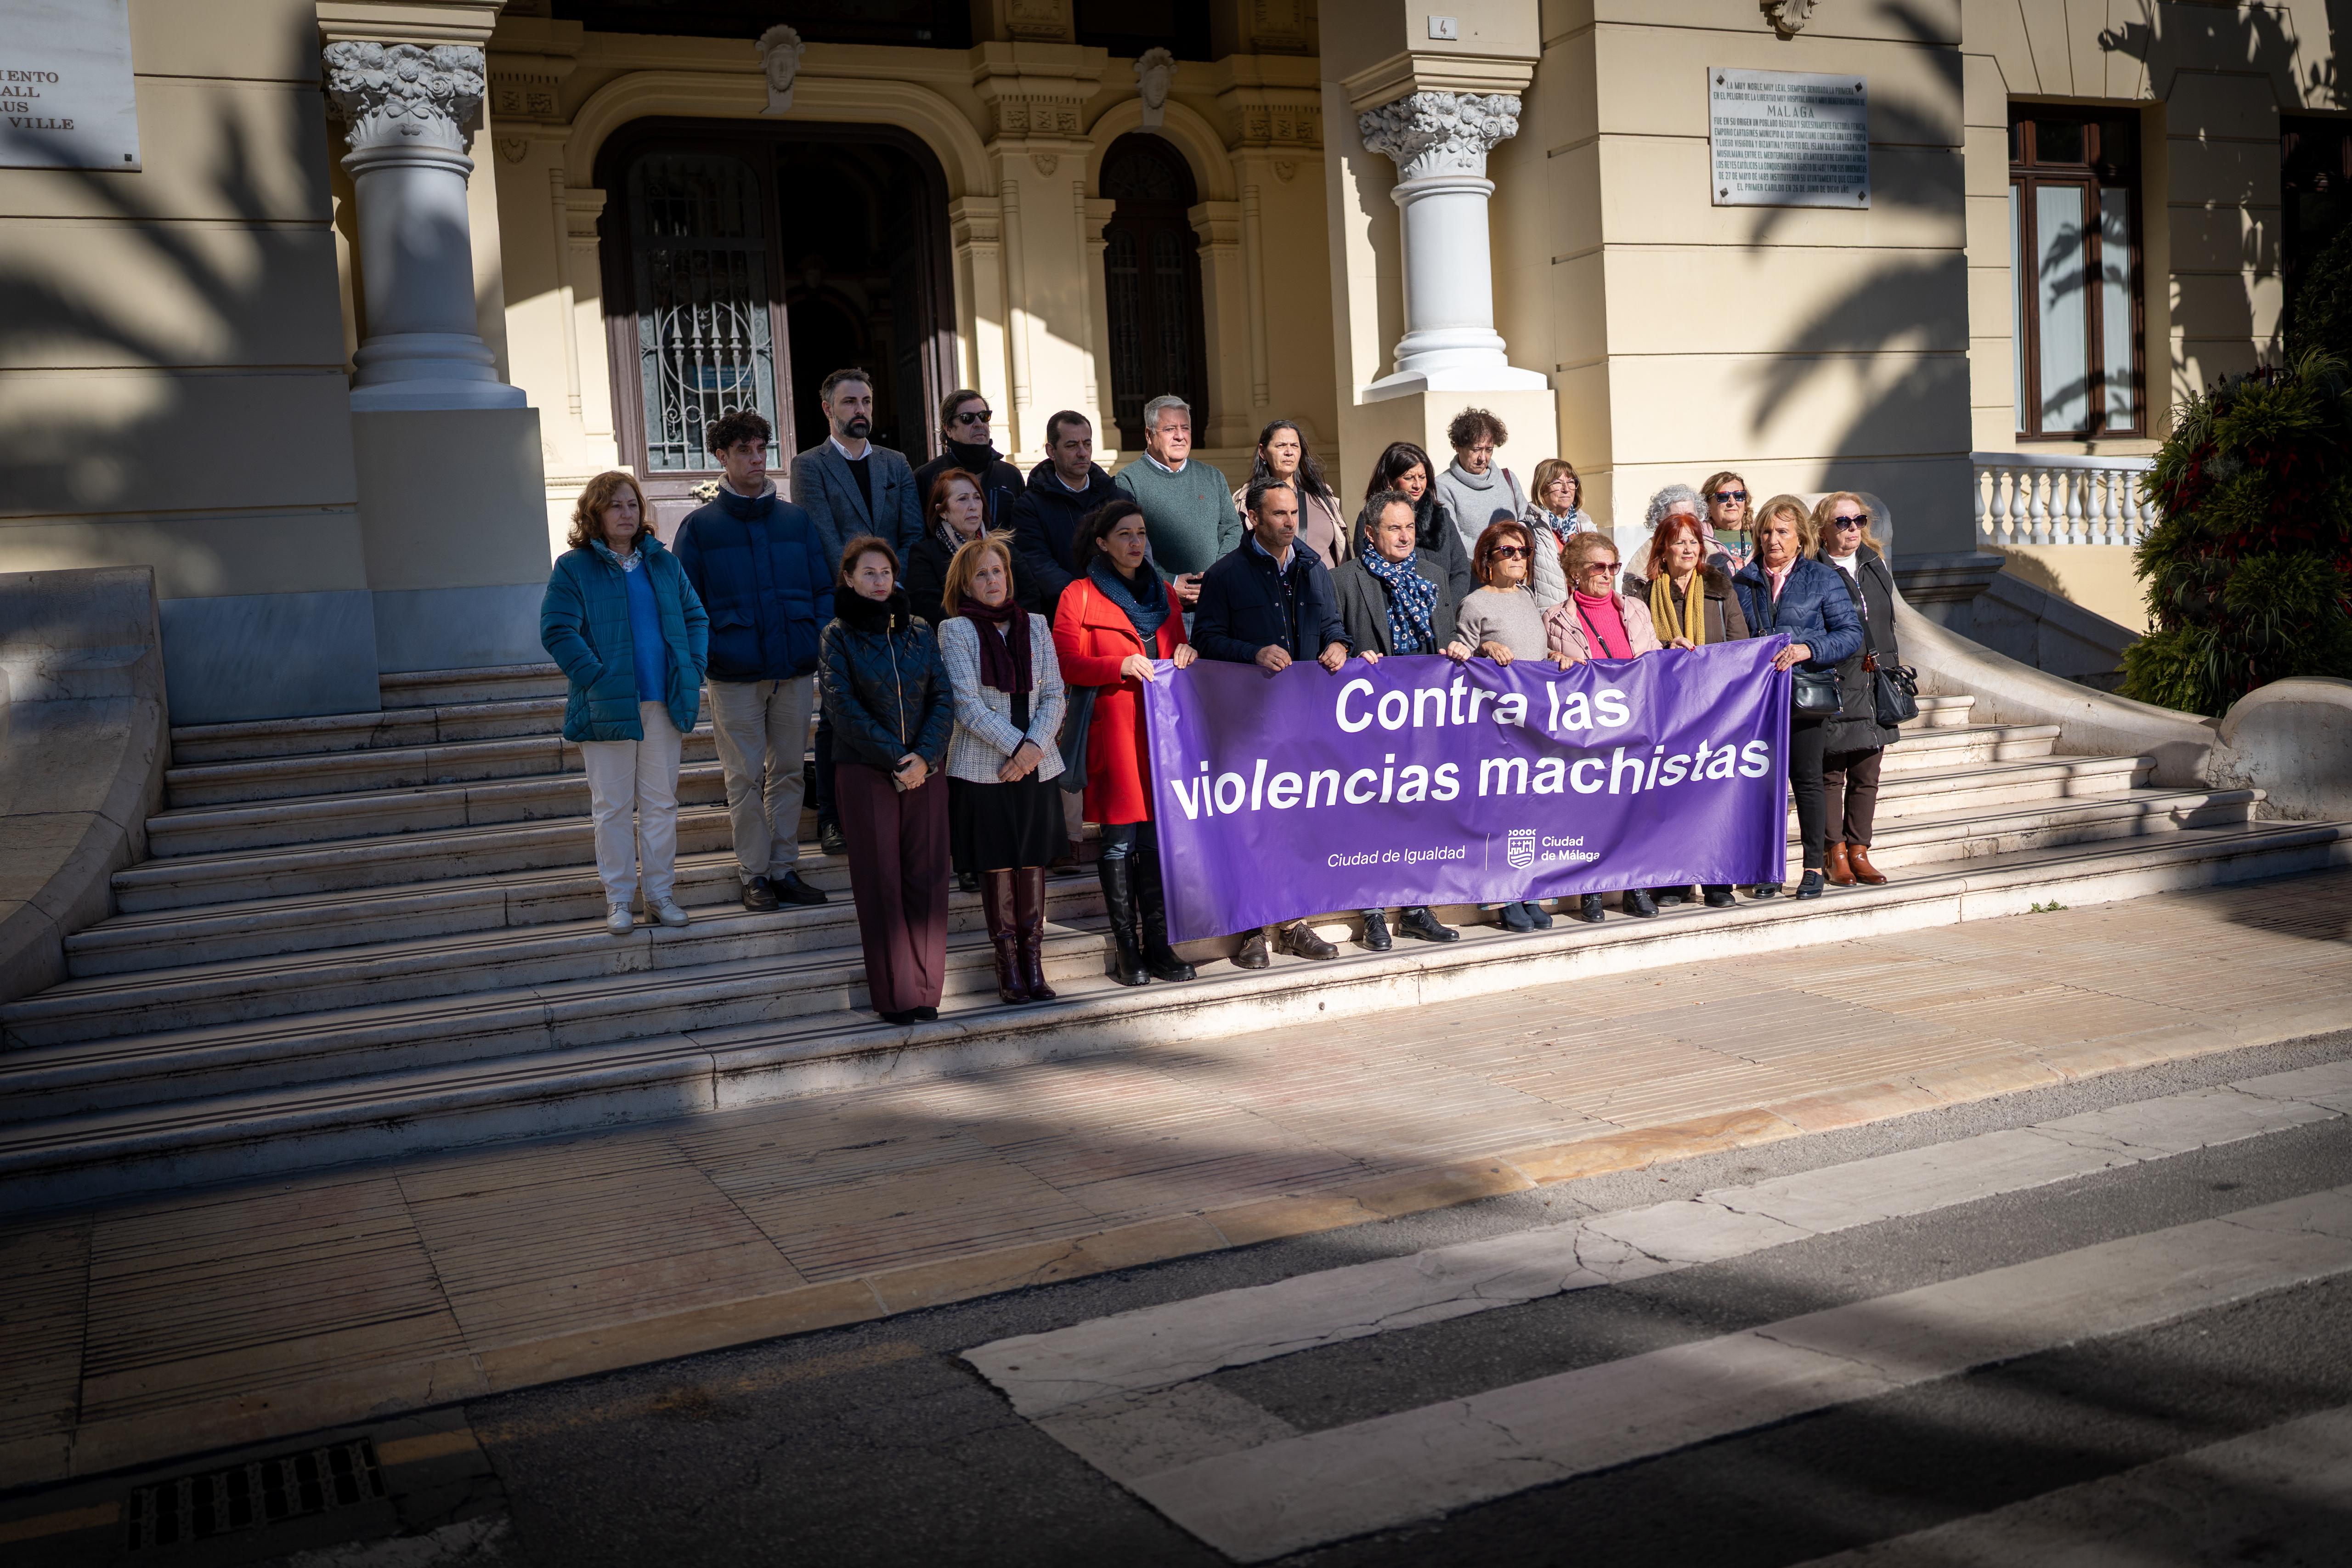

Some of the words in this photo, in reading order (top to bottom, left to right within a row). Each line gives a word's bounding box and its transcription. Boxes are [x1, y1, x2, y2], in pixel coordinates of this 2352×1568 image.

[1440, 20, 1447, 34] 4
[1735, 82, 1746, 91] MUY
[1764, 83, 1773, 91] MUY
[1787, 84, 1806, 93] SIEMPRE
[1829, 86, 1834, 94] LA
[1835, 86, 1854, 95] PRIMERA
[1726, 92, 1744, 101] PELIGRO
[1787, 95, 1815, 104] HOSPITALARIA
[1767, 103, 1815, 118] MÁLAGA
[8, 117, 74, 129] VILLE
[1713, 117, 1723, 125] FUE
[1730, 118, 1736, 126] SU
[1736, 118, 1752, 126] ORIGEN
[1759, 119, 1778, 127] POBLADO
[1801, 120, 1832, 130] SUCESIVAMENTE
[1714, 128, 1733, 136] EMPORIO
[1759, 130, 1780, 138] MUNICIPIO
[1795, 131, 1816, 139] DOMICIANO
[1719, 139, 1734, 147] LUEGO
[1784, 141, 1801, 149] PUERTO
[1764, 162, 1792, 171] CONQUISTARON
[1798, 163, 1812, 171] AGOSTO
[1758, 173, 1769, 181] 1489
[1770, 173, 1800, 182] INSTITUYERON
[1838, 175, 1846, 184] QUE
[1736, 183, 1744, 191] EL
[1745, 183, 1763, 192] PRIMER
[1764, 184, 1784, 192] CABILDO
[1336, 674, 1528, 733] Contra
[1546, 681, 1630, 732] las
[1170, 753, 1460, 820] violencias
[1478, 739, 1770, 797] machistas
[1542, 836, 1584, 847] Ciudad
[1328, 849, 1379, 867] Ciudad
[1382, 849, 1400, 863] de
[1404, 845, 1465, 865] Igualdad
[1541, 850, 1556, 860] de
[1559, 849, 1600, 862] Málaga
